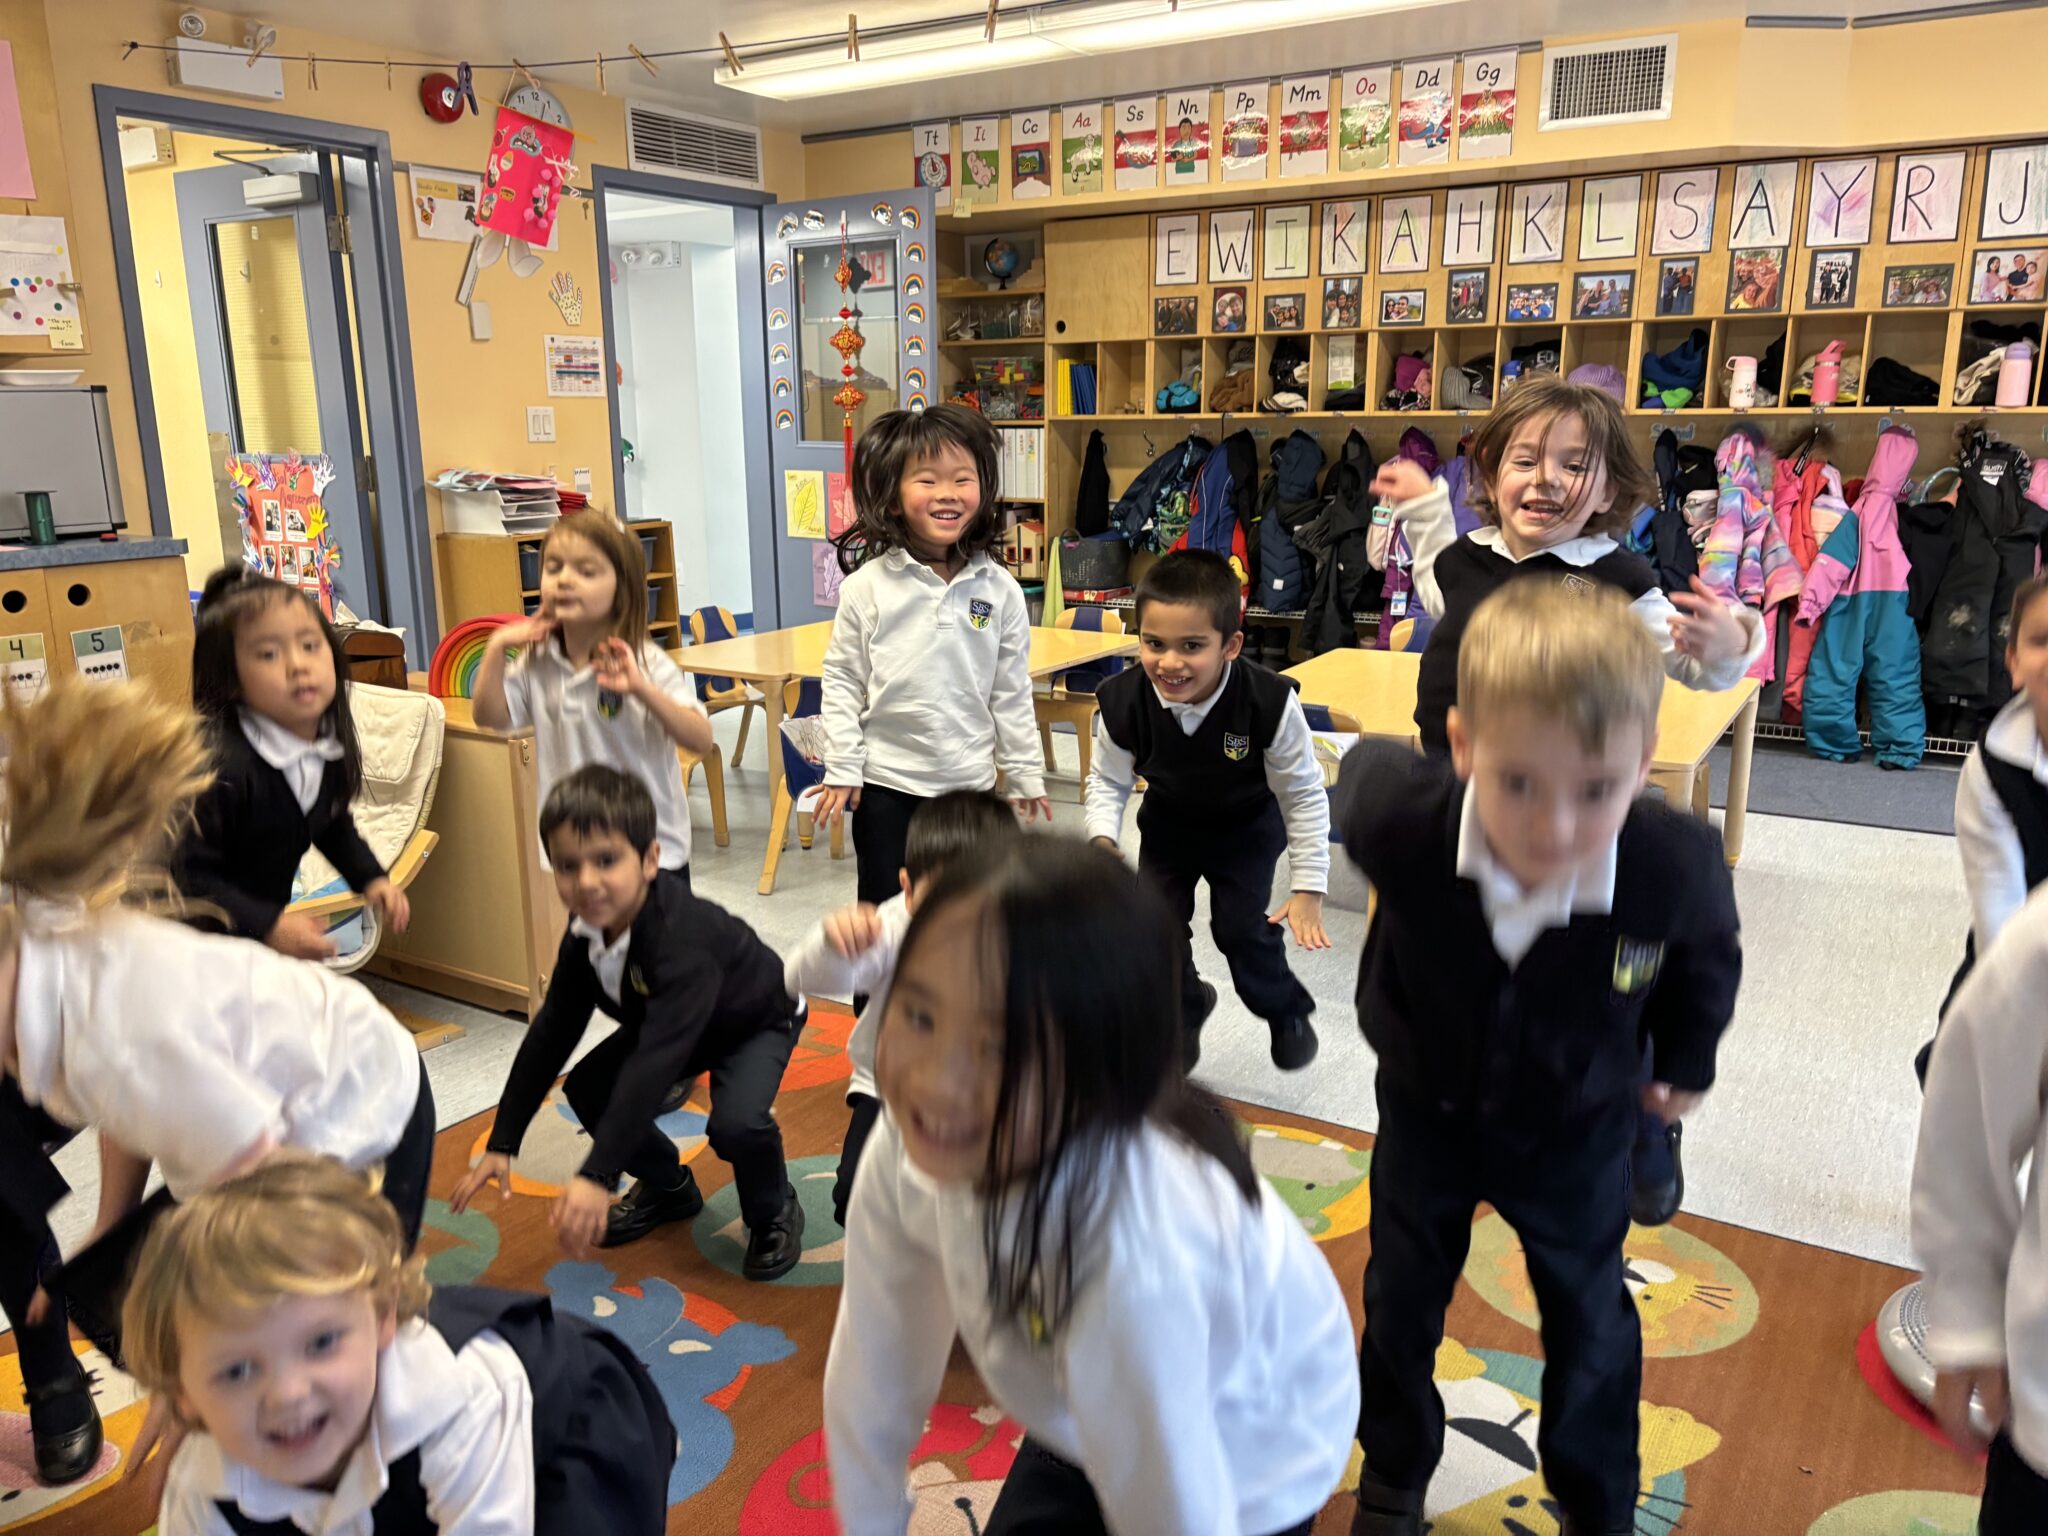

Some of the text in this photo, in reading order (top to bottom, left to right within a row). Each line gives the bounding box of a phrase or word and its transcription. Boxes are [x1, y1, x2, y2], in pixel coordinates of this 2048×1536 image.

[1415, 67, 1441, 89] Dd
[1476, 62, 1501, 87] Gg
[531, 91, 540, 102] 12
[1289, 84, 1321, 104] Mm
[1355, 77, 1377, 95] Oo
[517, 95, 525, 105] 11
[547, 101, 551, 110] 1
[1177, 99, 1200, 115] Nn
[1236, 92, 1255, 113] Pp
[556, 114, 562, 124] 2
[1071, 112, 1092, 128] Aa
[1126, 105, 1144, 122] Ss
[973, 126, 986, 142] Ii
[1022, 118, 1038, 135] Cc
[924, 130, 939, 146] Tt
[1820, 164, 1868, 238] Y
[1901, 164, 1933, 232] R
[1998, 161, 2030, 226] J
[1596, 192, 1624, 243] L
[1669, 181, 1699, 240] S
[1732, 178, 1775, 240] A
[1455, 200, 1484, 255] H
[1522, 193, 1554, 254] K
[1214, 218, 1251, 274] W
[1274, 218, 1298, 271] I
[1332, 211, 1358, 265] K
[1386, 208, 1419, 264] A
[1167, 228, 1187, 276] E
[9, 639, 24, 659] 4
[90, 632, 105, 652] 5
